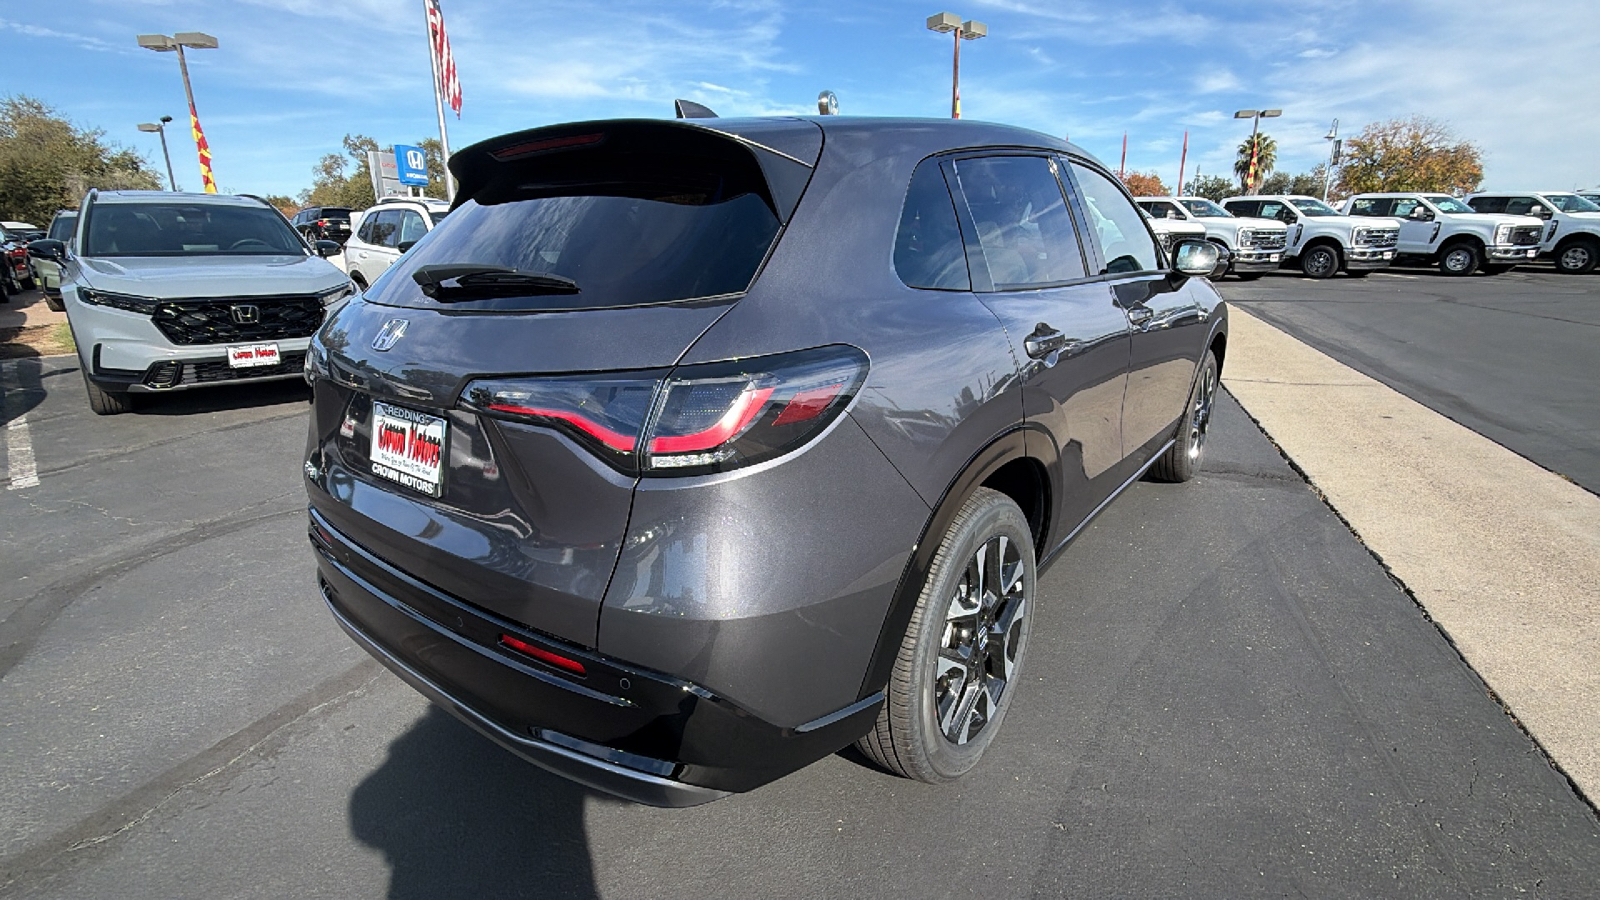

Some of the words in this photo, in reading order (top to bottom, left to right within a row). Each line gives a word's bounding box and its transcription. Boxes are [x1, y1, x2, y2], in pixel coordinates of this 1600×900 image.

[388, 406, 425, 423] REDDING
[378, 421, 406, 456] Crown
[407, 421, 440, 468] Motors
[372, 463, 400, 482] CROWN
[401, 472, 434, 494] MOTORS
